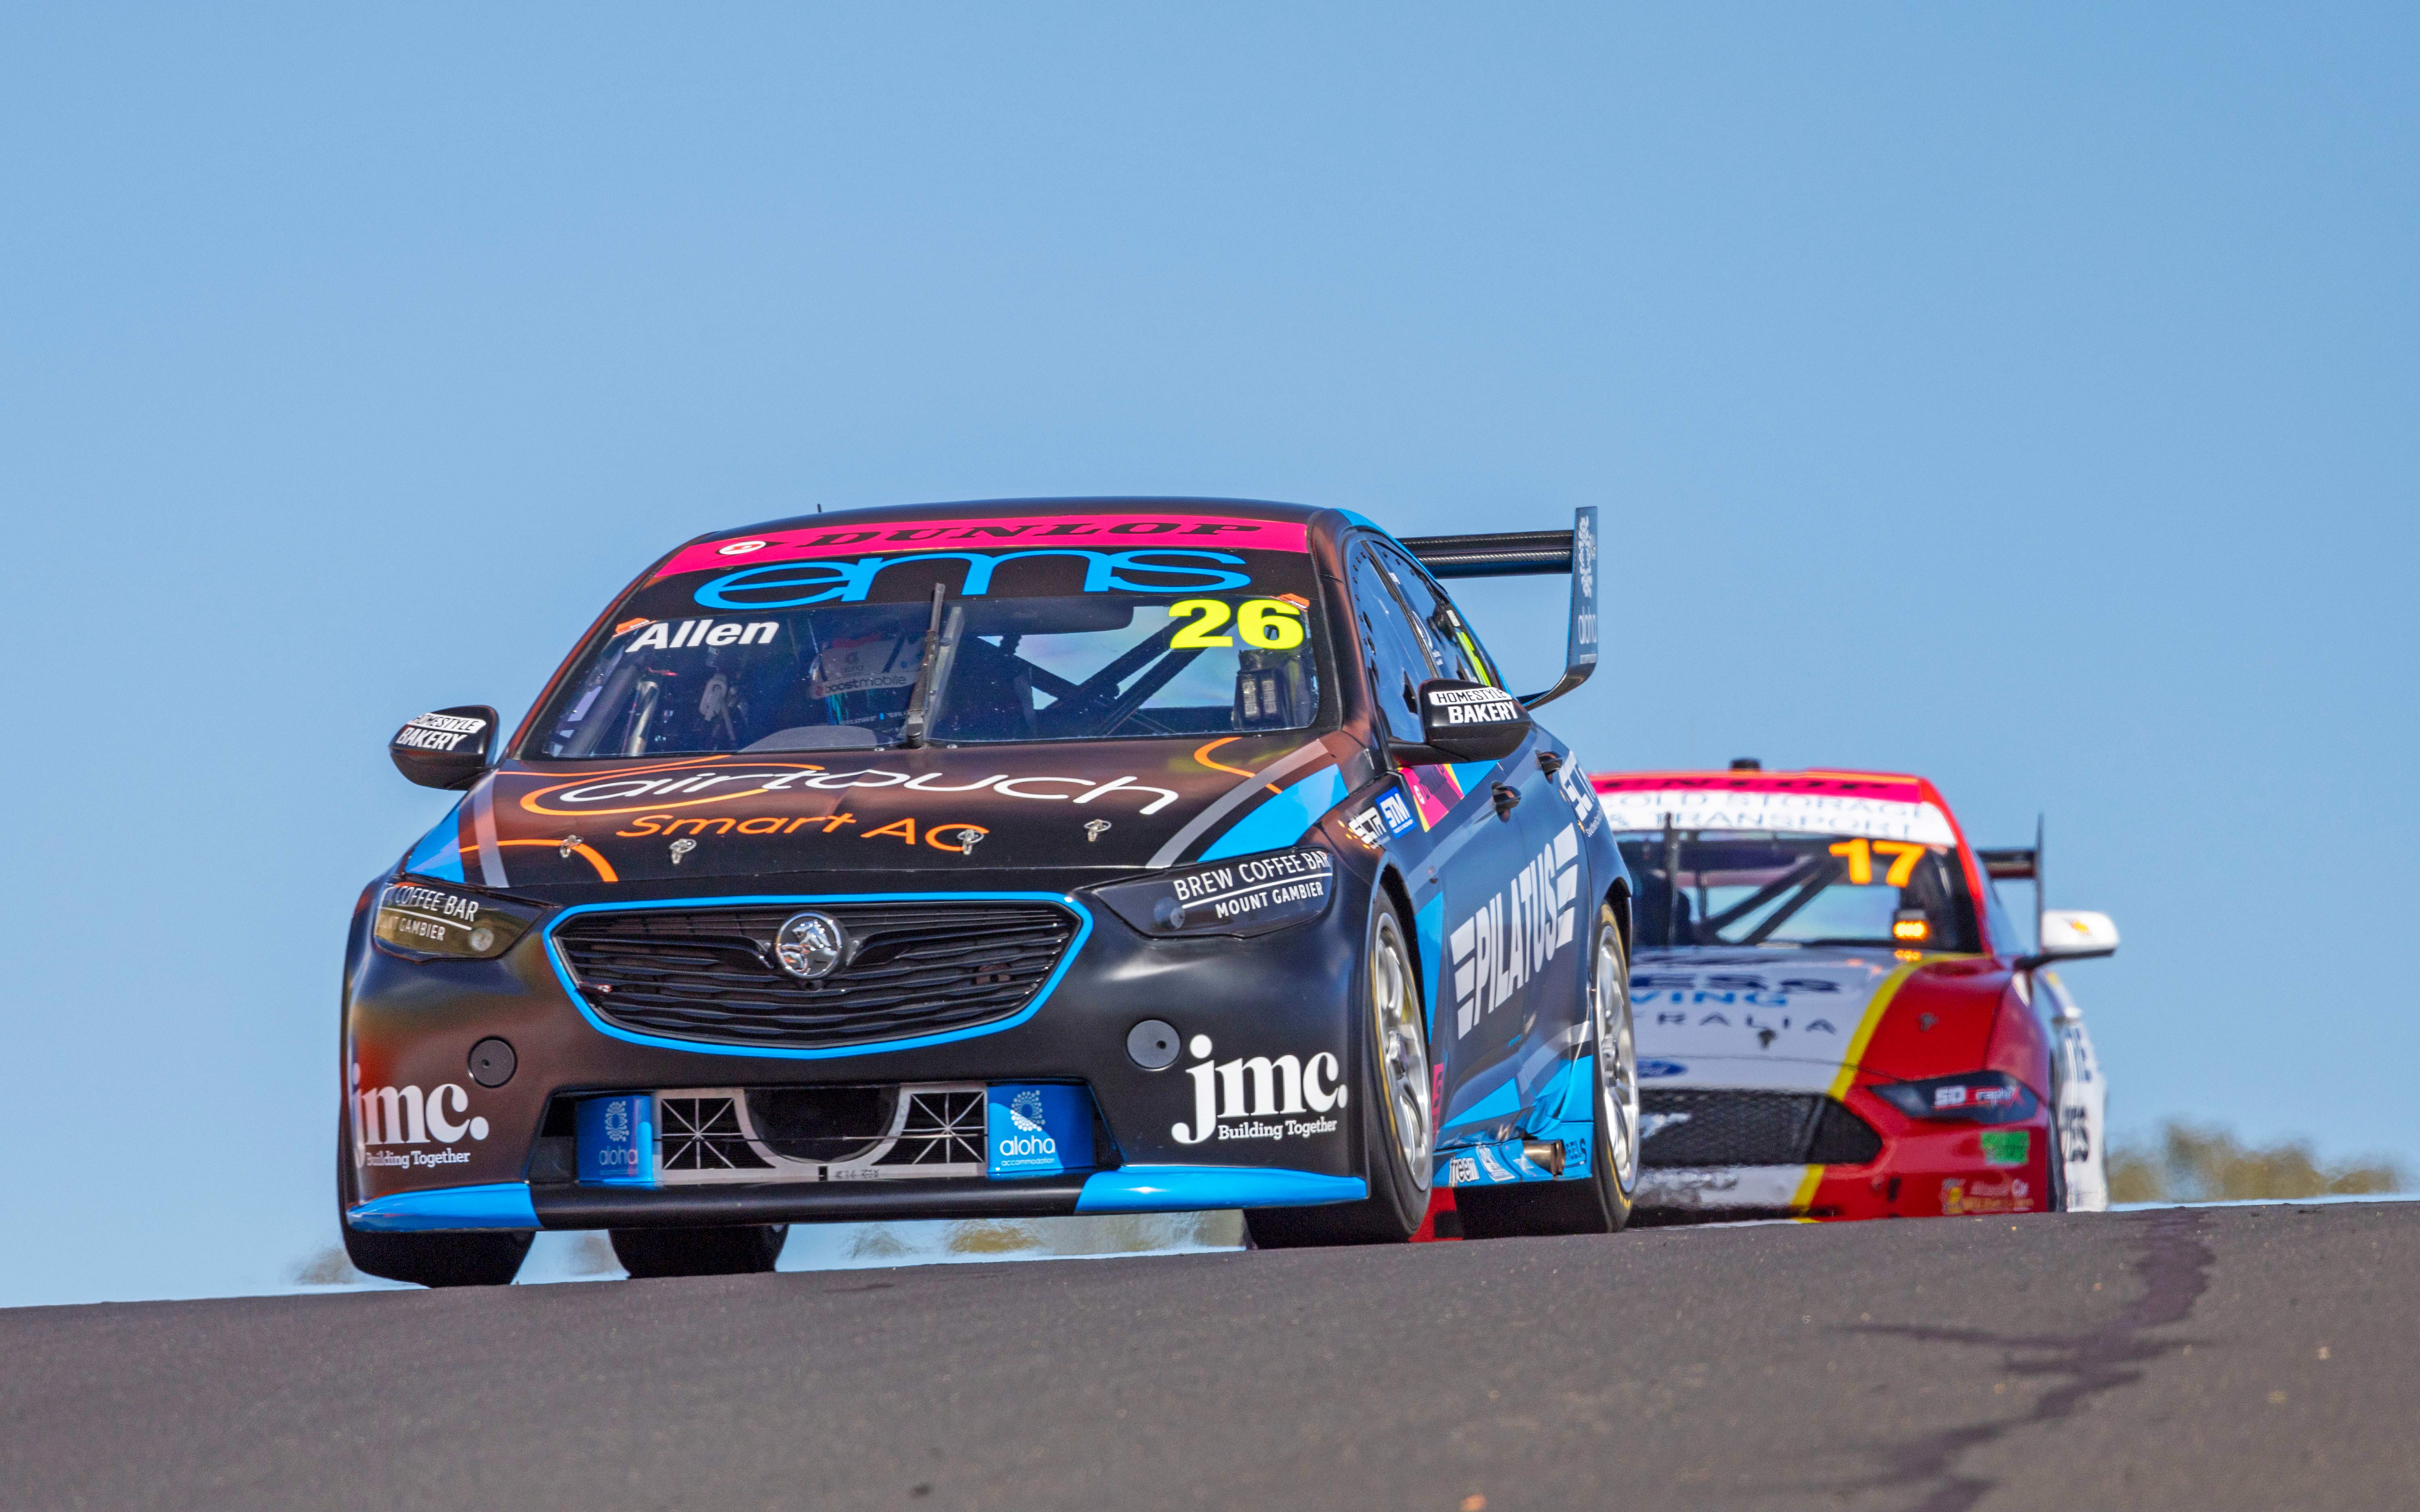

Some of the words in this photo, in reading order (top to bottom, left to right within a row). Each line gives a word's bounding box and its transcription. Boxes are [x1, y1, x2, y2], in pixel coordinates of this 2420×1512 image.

[796, 523, 1262, 548] DUNLOP
[694, 549, 1251, 609] ems
[626, 619, 779, 653] Allen
[1168, 599, 1304, 649] 26
[1438, 688, 1508, 703] HOMESTYLE
[1448, 701, 1519, 724] BAKERY
[395, 727, 468, 751] BAKERY
[560, 770, 1179, 815] airtouch
[1604, 792, 1708, 808] OLD
[616, 813, 857, 837] Smart
[861, 818, 989, 852] AC
[1174, 868, 1233, 901] BREW
[1239, 855, 1305, 883] COFFEE
[1306, 850, 1333, 872] BAR
[1829, 839, 1926, 887] 17
[395, 886, 445, 912] COFFEE
[444, 896, 479, 922] BAR
[1216, 892, 1268, 918] MOUNT
[1273, 882, 1324, 904] GAMBIER
[399, 918, 446, 941] GAMBIER
[1475, 843, 1558, 1026] PILATUS
[1634, 1011, 1836, 1035] RALIA
[1218, 1121, 1283, 1140] Building
[1286, 1117, 1337, 1137] Together
[411, 1148, 471, 1168] Together
[999, 1135, 1056, 1156] aloha
